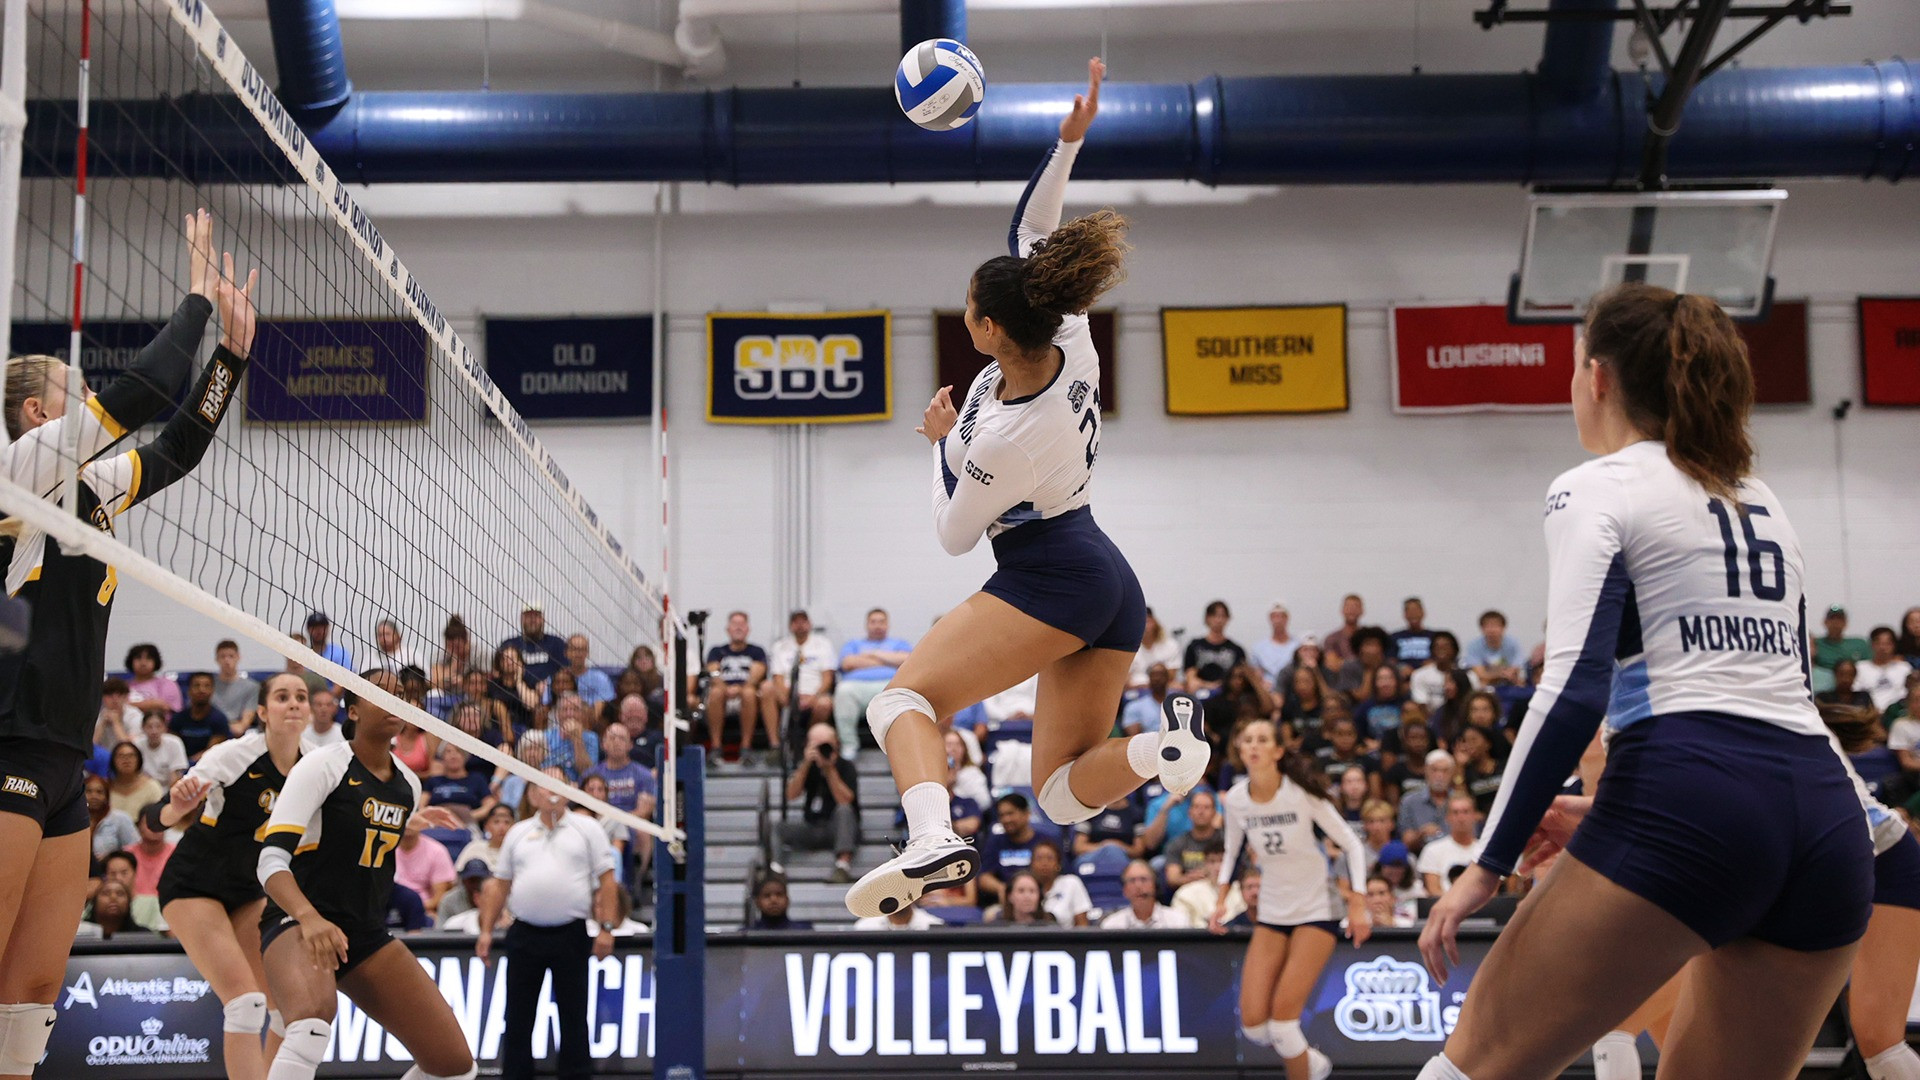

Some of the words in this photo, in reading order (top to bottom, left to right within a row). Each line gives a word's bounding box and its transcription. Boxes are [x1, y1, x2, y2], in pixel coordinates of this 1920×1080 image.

[301, 346, 375, 369] JAMES
[553, 343, 596, 366] OLD
[1196, 335, 1314, 358] SOUTHERN
[1427, 343, 1546, 369] LOUISIANA
[734, 334, 863, 400] SBC
[1229, 363, 1283, 386] MISS
[201, 365, 231, 418] RAMS
[287, 373, 388, 397] MADISON
[521, 371, 629, 395] DOMINION
[965, 460, 994, 485] SBC
[1707, 497, 1786, 602] 16
[4, 777, 38, 797] RAMS
[363, 797, 407, 829] VCU
[358, 828, 401, 868] 17
[1261, 831, 1287, 856] 22
[99, 977, 173, 996] Atlantic
[173, 976, 211, 997] Bay
[784, 949, 1199, 1057] VOLLEYBALL
[1338, 998, 1441, 1037] ODU
